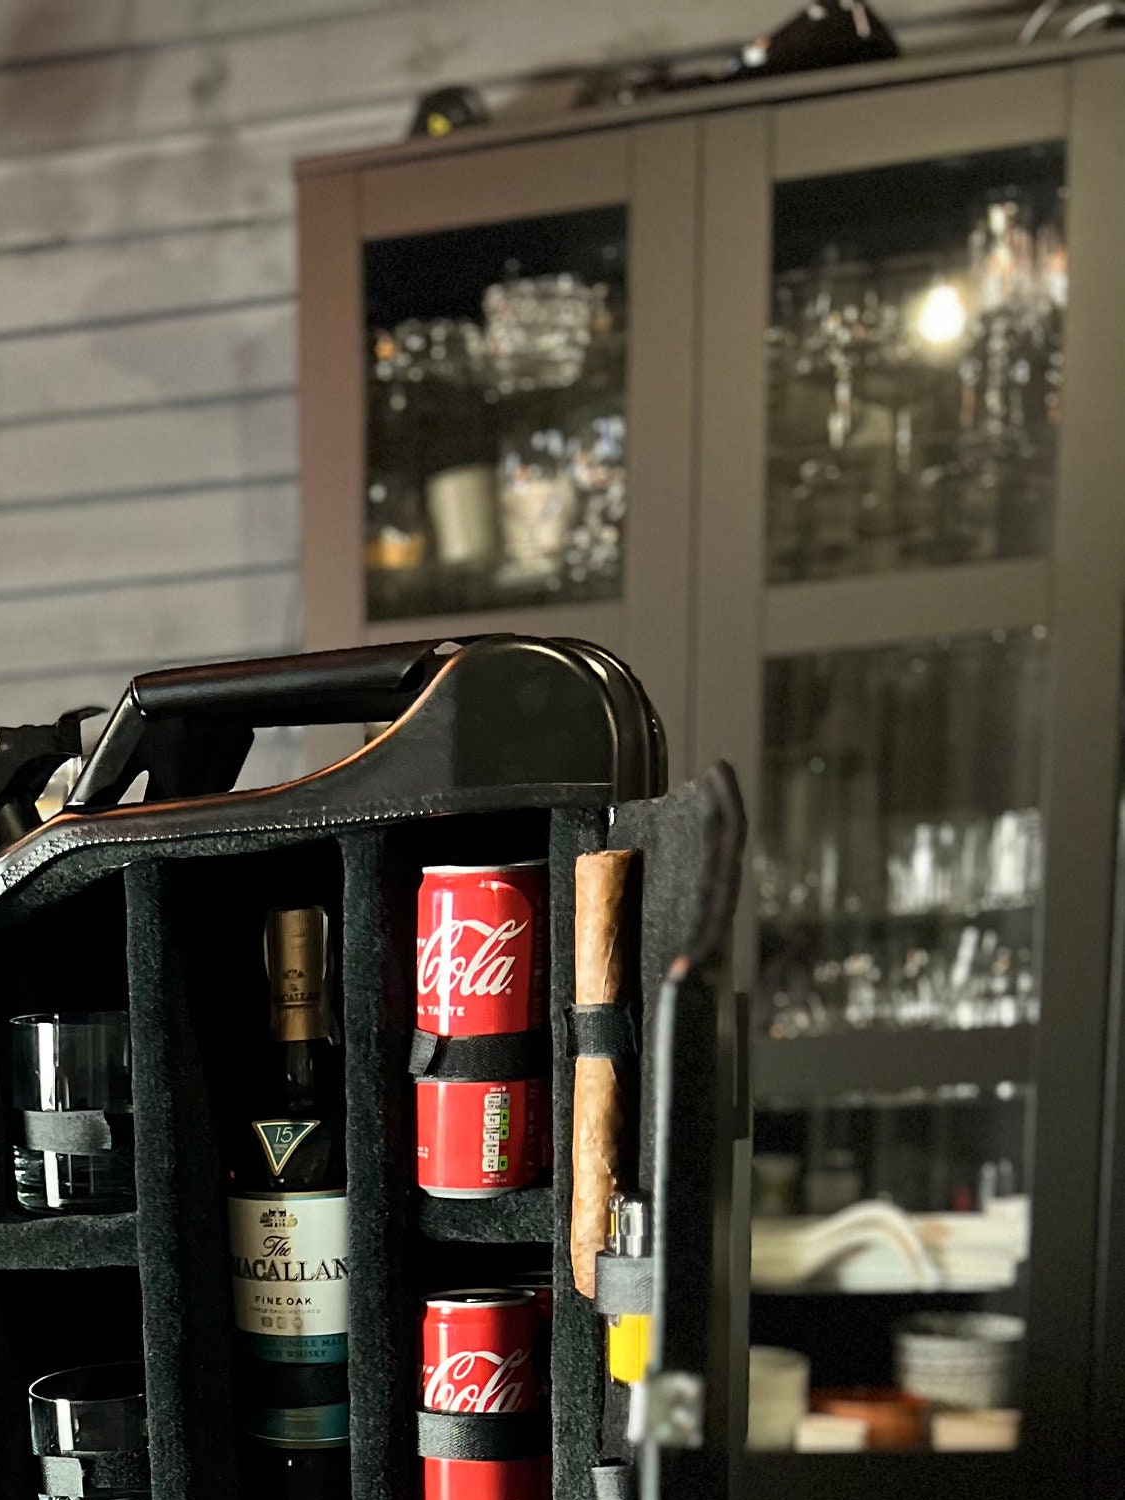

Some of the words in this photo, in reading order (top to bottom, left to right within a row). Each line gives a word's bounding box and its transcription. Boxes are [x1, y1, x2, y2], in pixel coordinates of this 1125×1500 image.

[418, 919, 529, 996] Cola
[427, 1006, 465, 1016] TATE
[276, 1126, 294, 1143] 15
[261, 1235, 291, 1257] The
[255, 1295, 282, 1306] FINE
[286, 1297, 312, 1306] OAK
[424, 1349, 531, 1413] Cola
